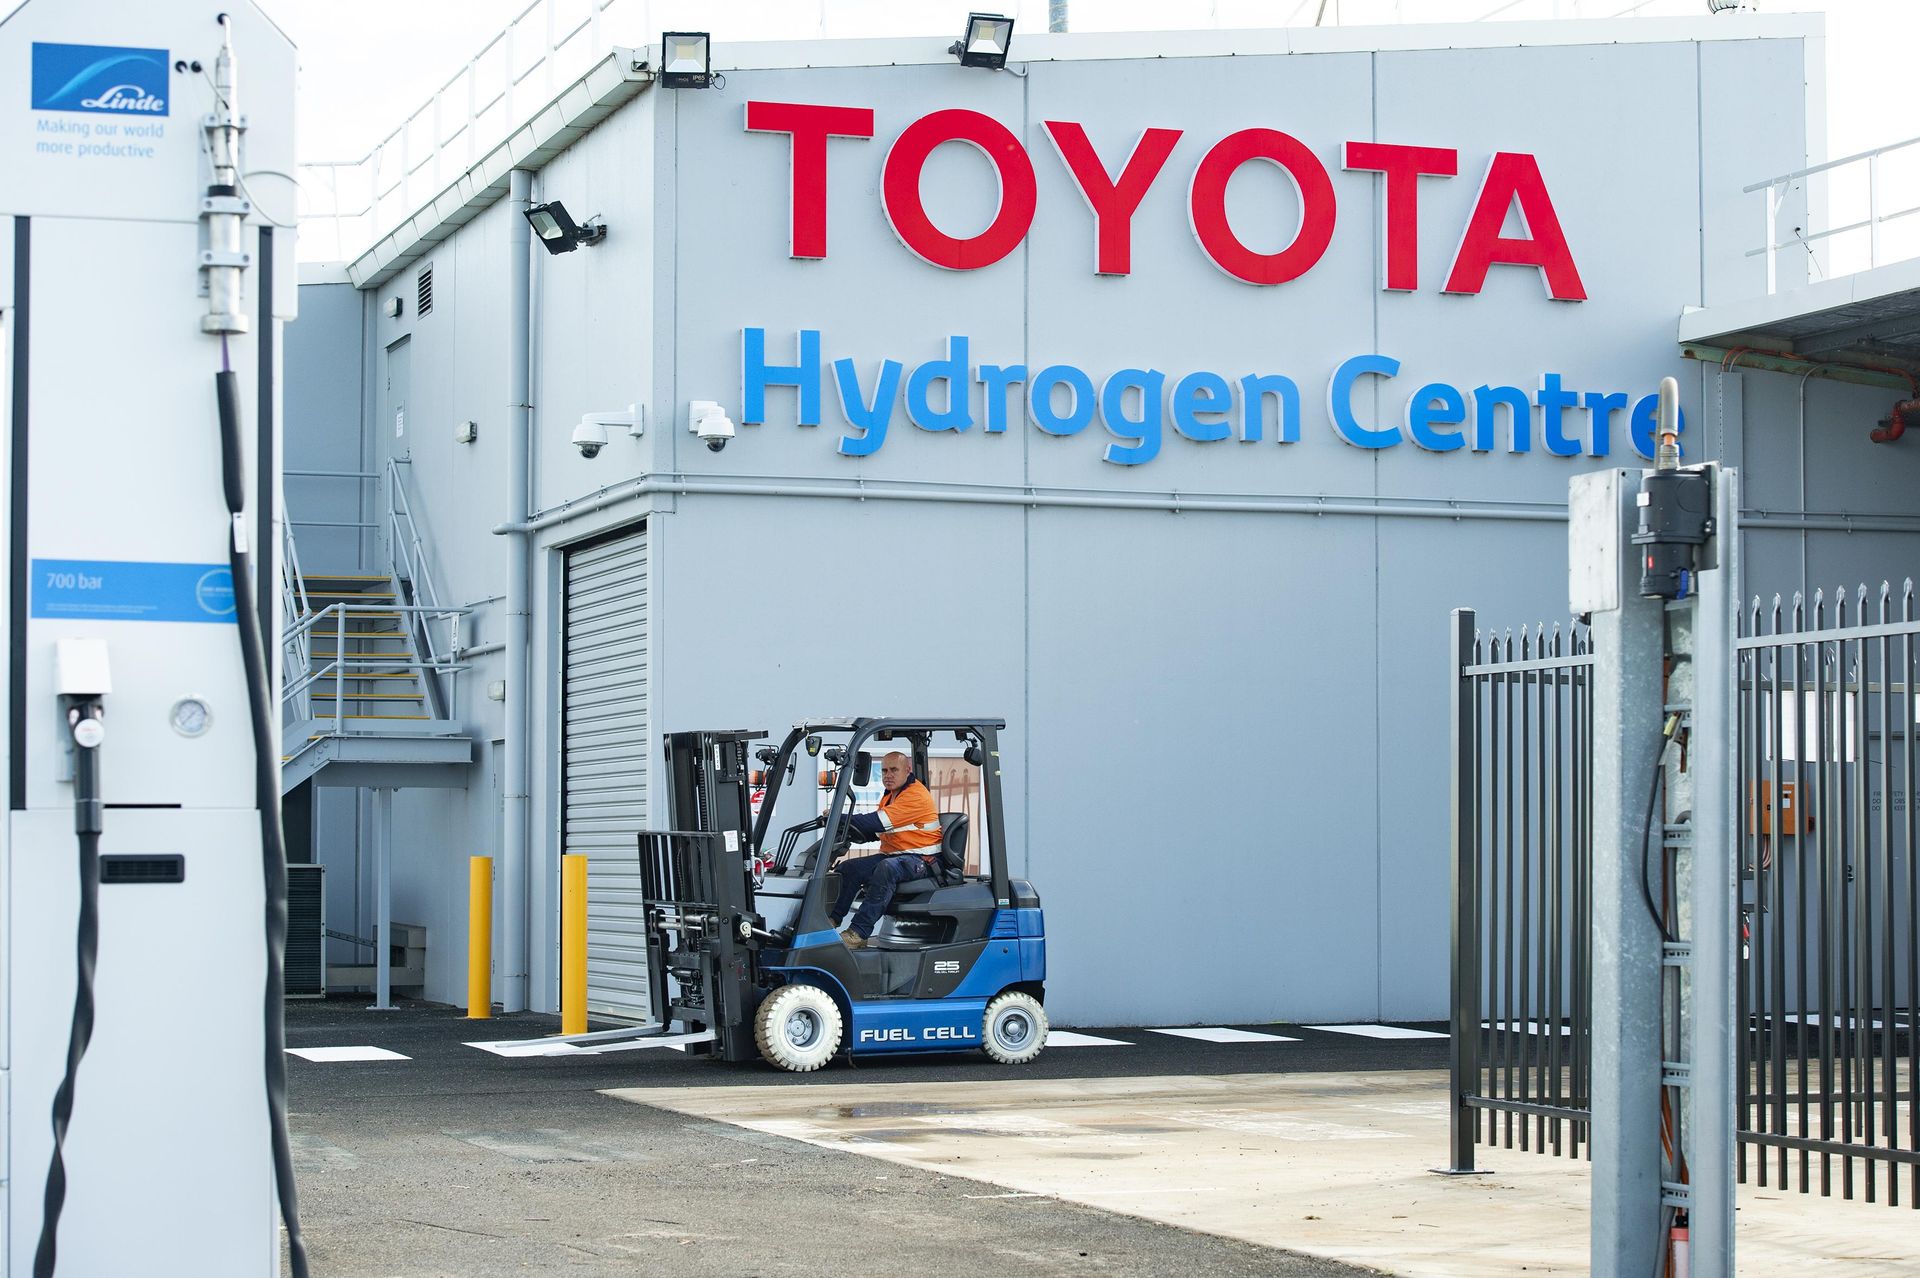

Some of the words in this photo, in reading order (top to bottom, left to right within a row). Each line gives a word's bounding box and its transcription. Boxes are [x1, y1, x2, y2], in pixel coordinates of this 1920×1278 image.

[81, 84, 165, 112] Linde
[36, 119, 90, 138] Making
[95, 123, 118, 136] our
[124, 124, 164, 138] world
[36, 141, 73, 154] more
[78, 142, 155, 158] productive
[743, 101, 1588, 303] TOYOTA
[741, 327, 1302, 465] Hydrogen
[1326, 354, 1686, 461] Centre
[47, 572, 75, 589] 700
[78, 573, 103, 590] bar
[934, 960, 960, 970] 25
[860, 1028, 916, 1042] FUEL
[923, 1025, 976, 1040] CELL
